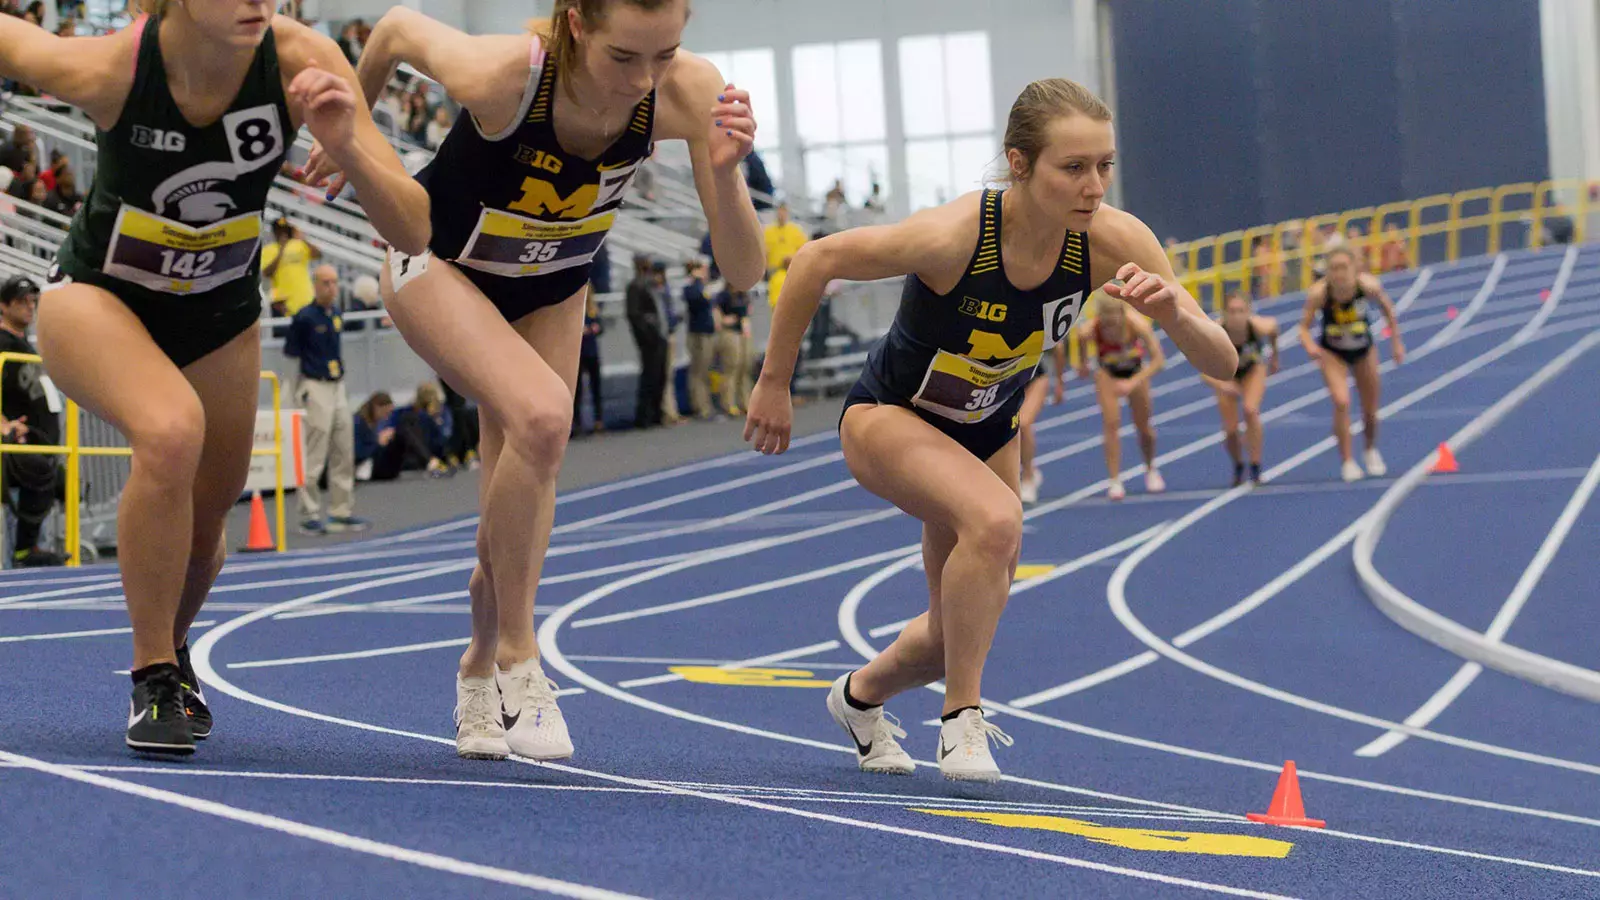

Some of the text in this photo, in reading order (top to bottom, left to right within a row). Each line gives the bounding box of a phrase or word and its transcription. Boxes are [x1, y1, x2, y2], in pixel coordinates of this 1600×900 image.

[235, 118, 276, 161] 8
[506, 175, 600, 219] M
[604, 168, 637, 203] 7
[160, 249, 217, 278] 142
[519, 241, 563, 263] 35
[1051, 297, 1074, 343] 6
[957, 328, 1044, 361] M
[965, 383, 1001, 411] 38
